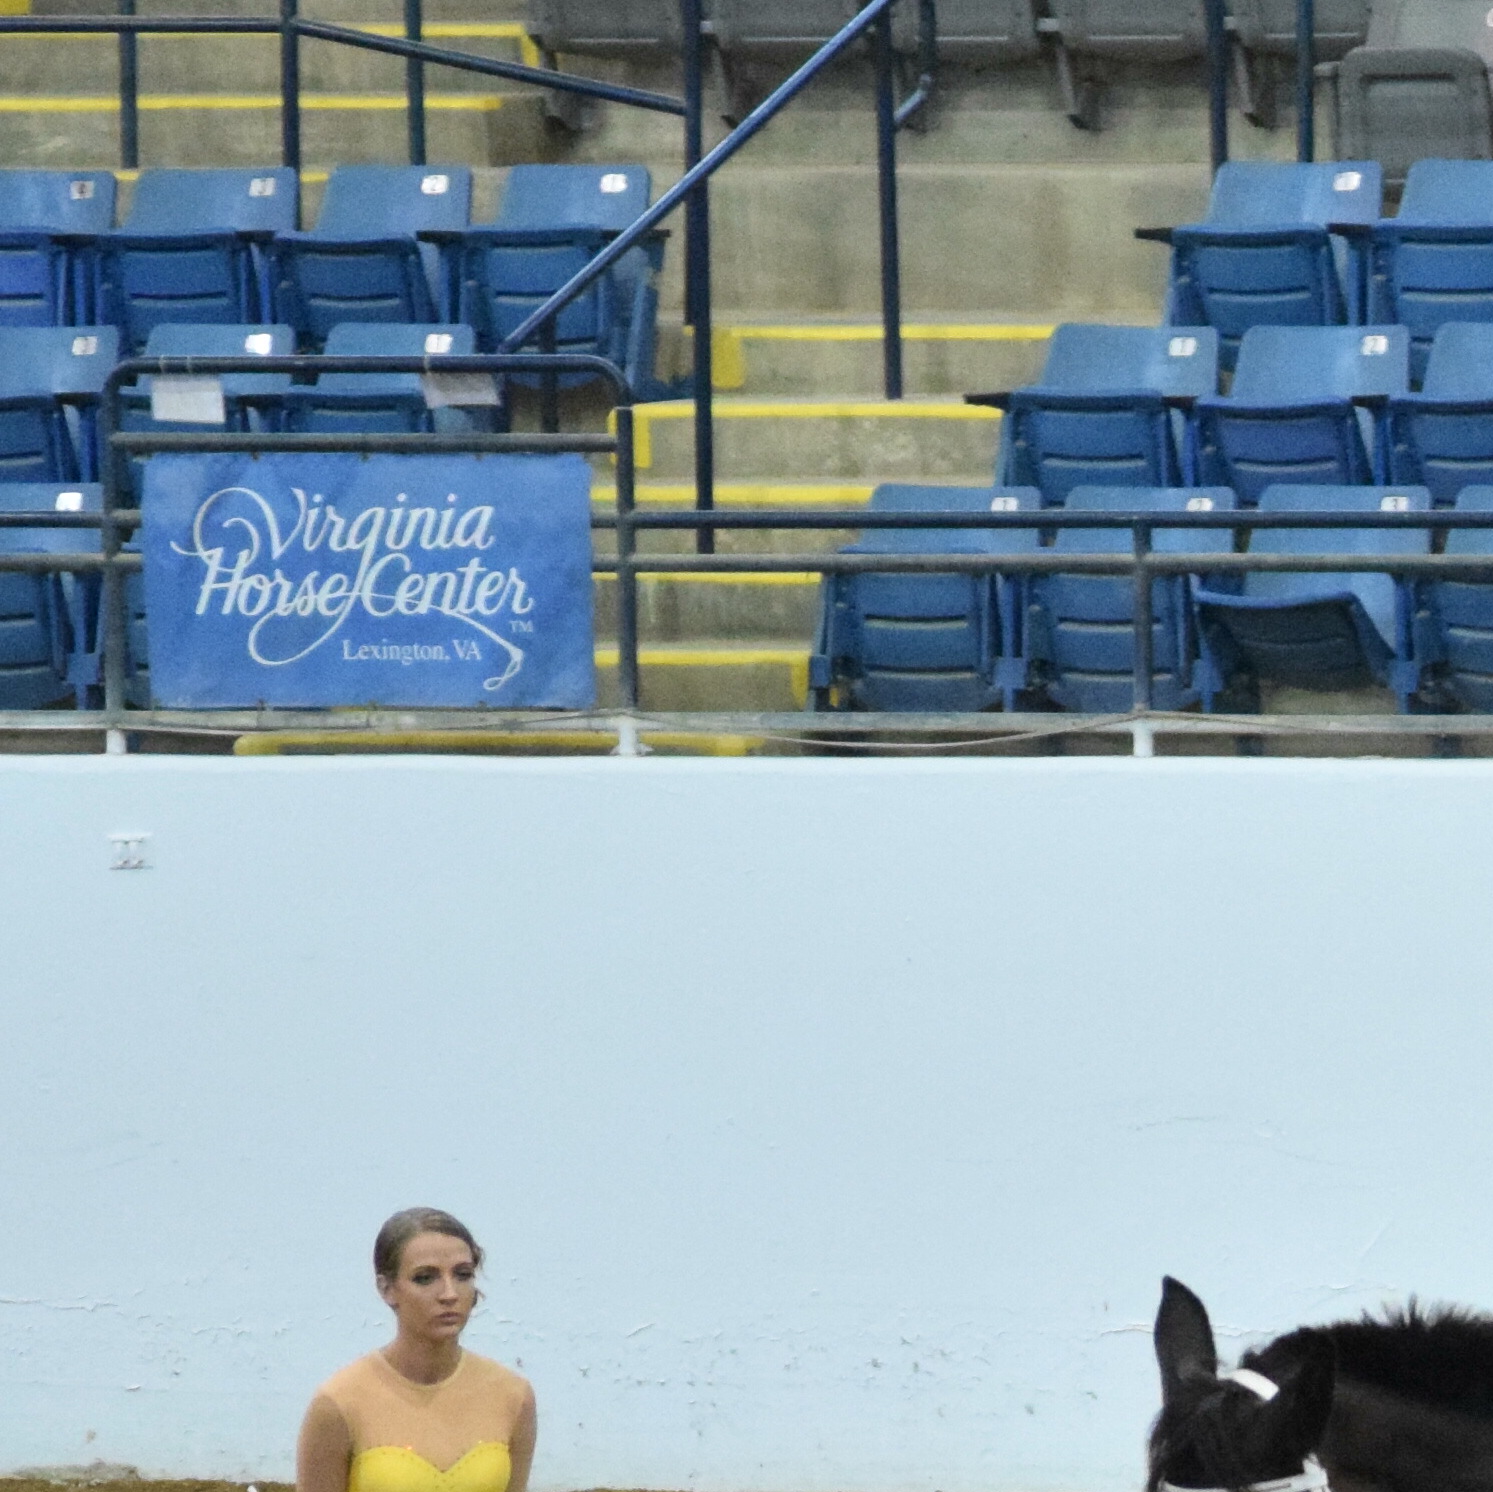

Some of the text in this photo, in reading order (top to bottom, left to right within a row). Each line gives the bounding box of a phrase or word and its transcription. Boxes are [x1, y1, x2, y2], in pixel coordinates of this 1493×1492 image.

[170, 486, 496, 564] Virginia
[196, 547, 534, 617] Horse Center
[509, 620, 534, 633] TM
[452, 639, 482, 661] VA
